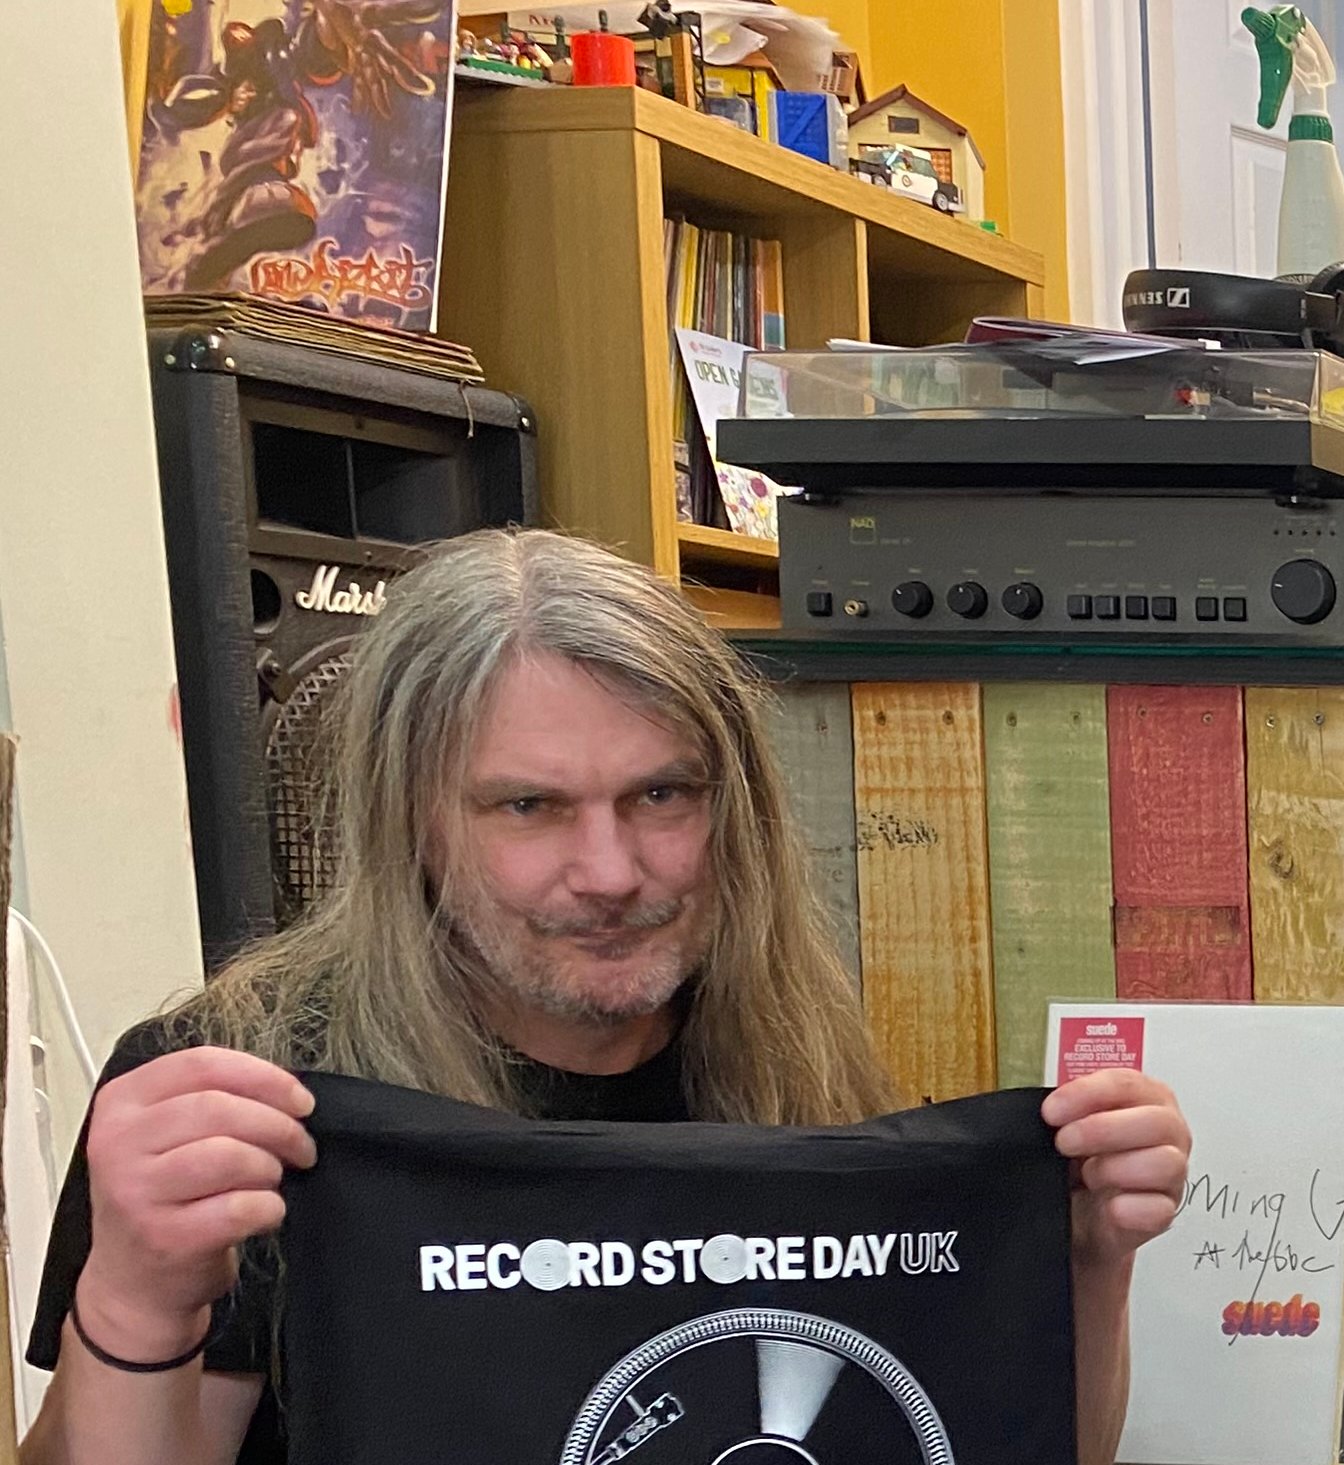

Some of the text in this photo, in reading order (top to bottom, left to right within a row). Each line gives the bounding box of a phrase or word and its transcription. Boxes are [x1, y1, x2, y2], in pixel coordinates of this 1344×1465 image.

[694, 360, 729, 386] OPEN
[850, 517, 875, 530] NAD
[295, 564, 387, 616] Marsh
[1085, 1022, 1118, 1036] suede
[419, 1231, 961, 1293] RECORD STORE DAY UK
[1221, 1293, 1321, 1338] suede
